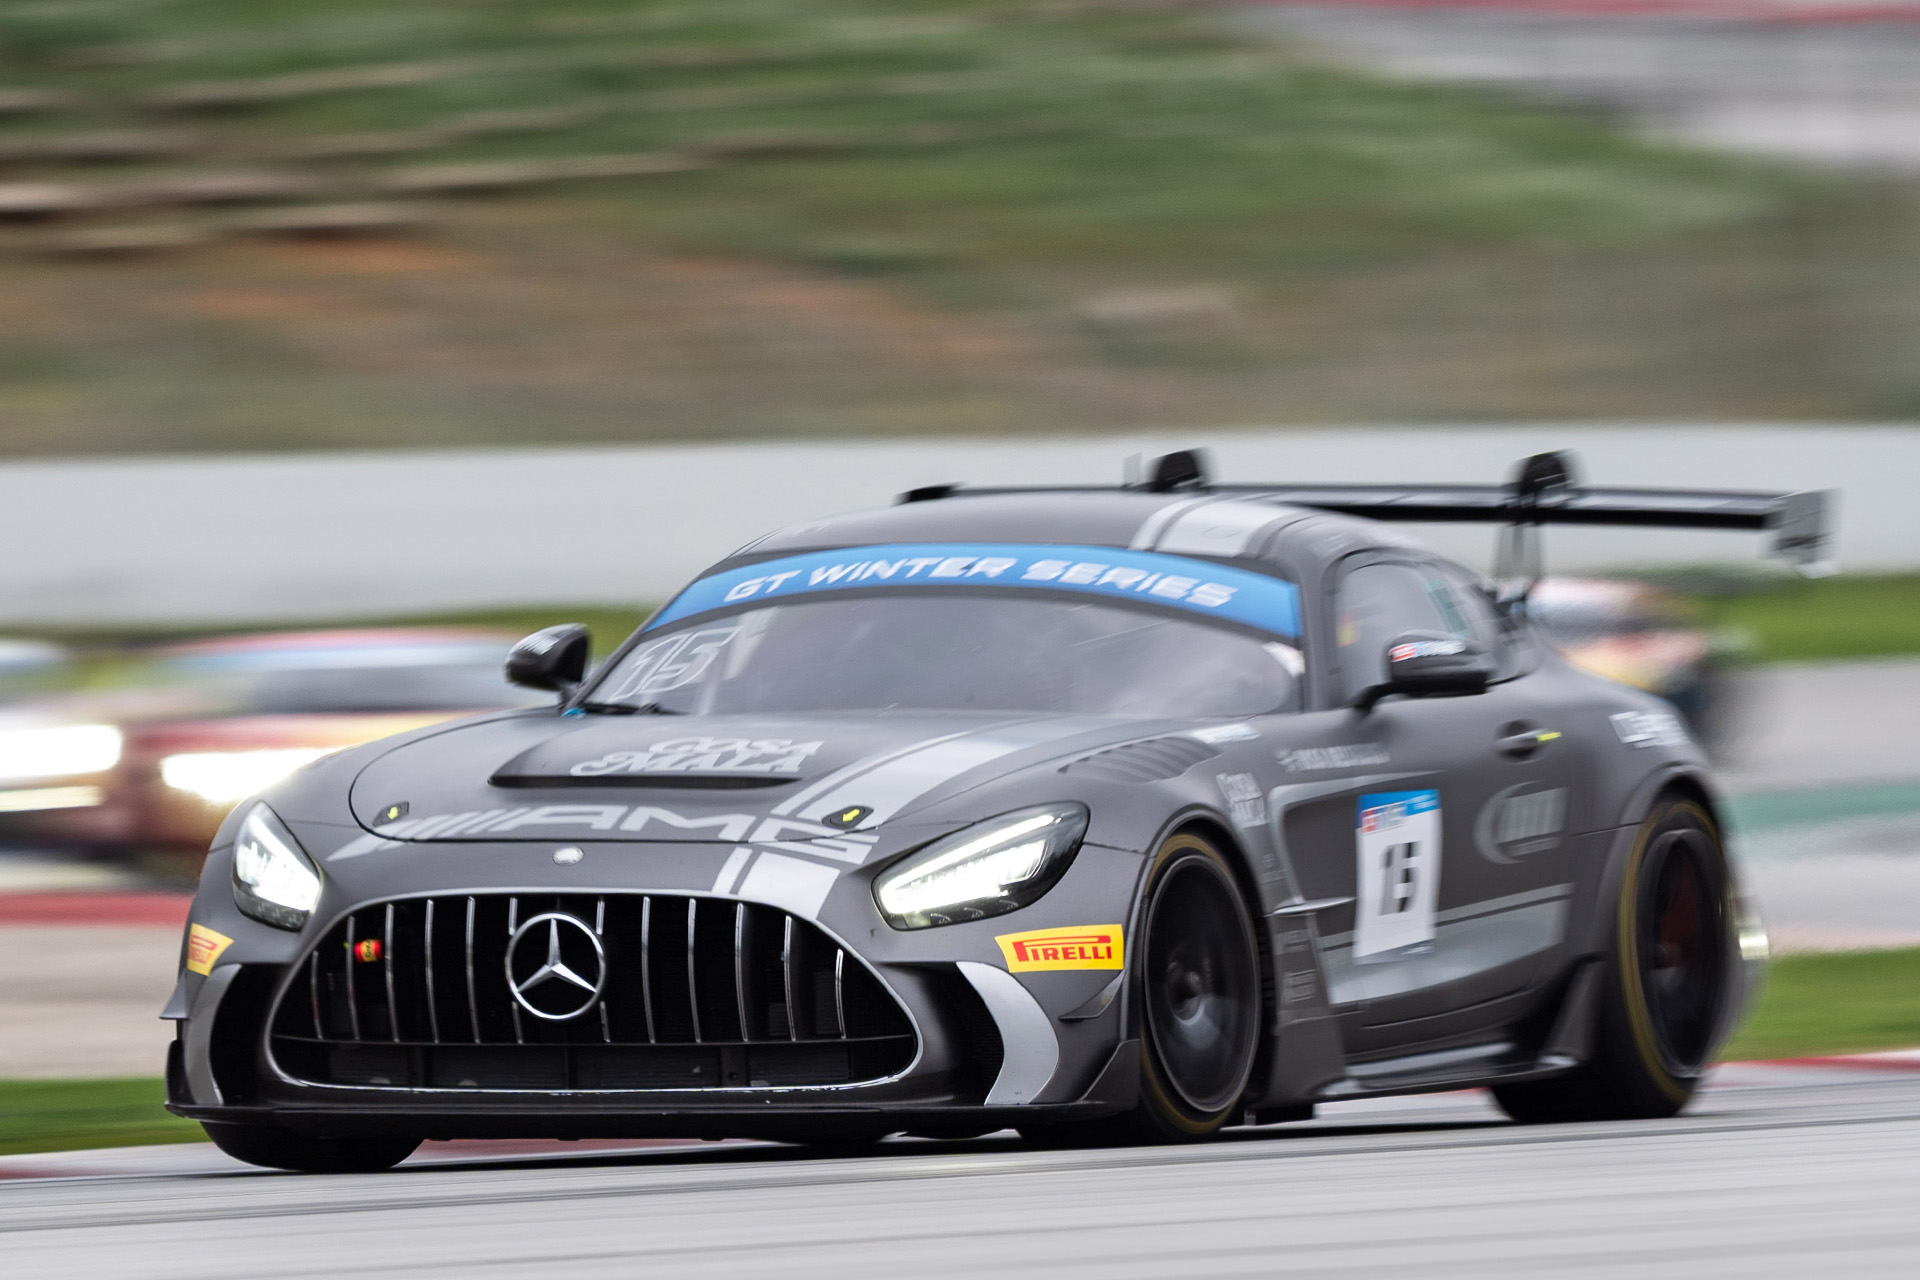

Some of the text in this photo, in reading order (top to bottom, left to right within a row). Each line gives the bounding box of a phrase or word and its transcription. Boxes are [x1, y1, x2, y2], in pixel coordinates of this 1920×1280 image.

[723, 556, 1239, 608] GT WINTER SERIES
[607, 625, 744, 703] 15
[569, 749, 805, 777] MALA
[648, 736, 825, 755] COSA
[487, 804, 881, 866] AMG
[1012, 935, 1113, 963] PIRELLI
